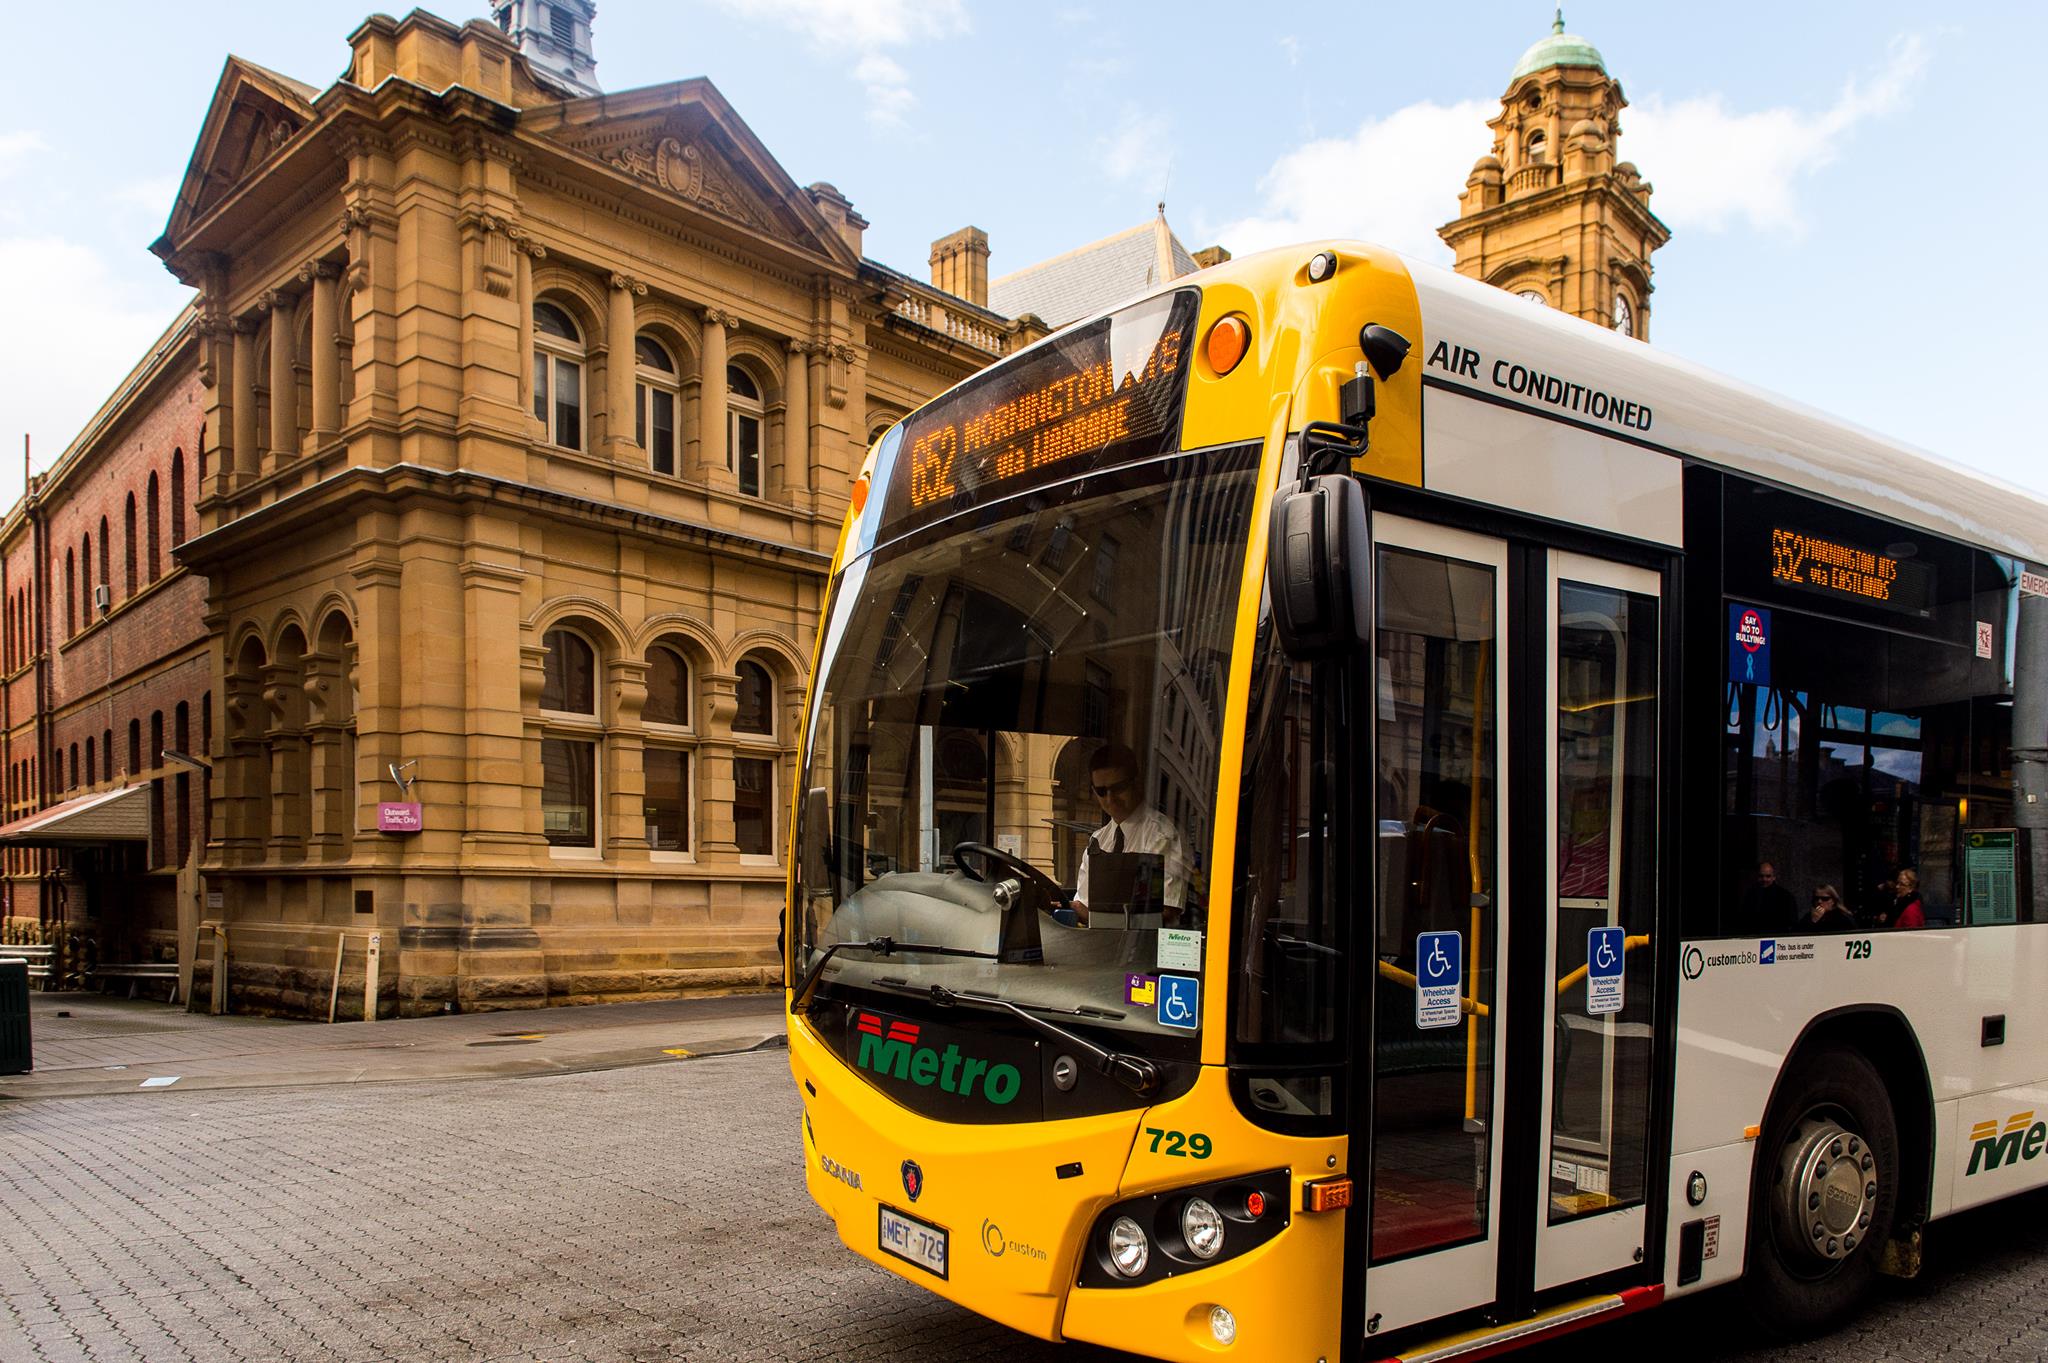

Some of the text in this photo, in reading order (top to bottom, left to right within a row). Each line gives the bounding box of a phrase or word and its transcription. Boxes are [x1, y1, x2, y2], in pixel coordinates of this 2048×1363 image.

[1427, 340, 1653, 432] AIR CONDITIONED
[911, 424, 957, 506] 652
[964, 360, 1113, 453] MORNINGTON
[997, 398, 1130, 479] via WARRANE
[1772, 529, 1897, 583] 652 MORNINGTON HTS
[1810, 563, 1889, 600] via EASTLANDS
[1741, 624, 1760, 635] NO TO
[1745, 615, 1757, 625] SAY
[1735, 632, 1766, 645] BULLYING!
[385, 816, 417, 824] Traffic Only
[1167, 933, 1191, 942] Metro
[1801, 942, 1814, 950] under
[1776, 952, 1814, 961] video surveillance
[1845, 940, 1872, 960] 729
[1592, 976, 1620, 986] Wheelchair
[1596, 986, 1616, 994] Access
[1422, 987, 1456, 997] Wheelchair
[1427, 998, 1451, 1006] Access
[857, 1013, 1021, 1105] Metro
[1146, 1127, 1212, 1160] 729
[1966, 1110, 2048, 1176] Me
[821, 1154, 863, 1192] SCANIA
[886, 1218, 944, 1262] MET 729
[1009, 1240, 1047, 1261] custom
